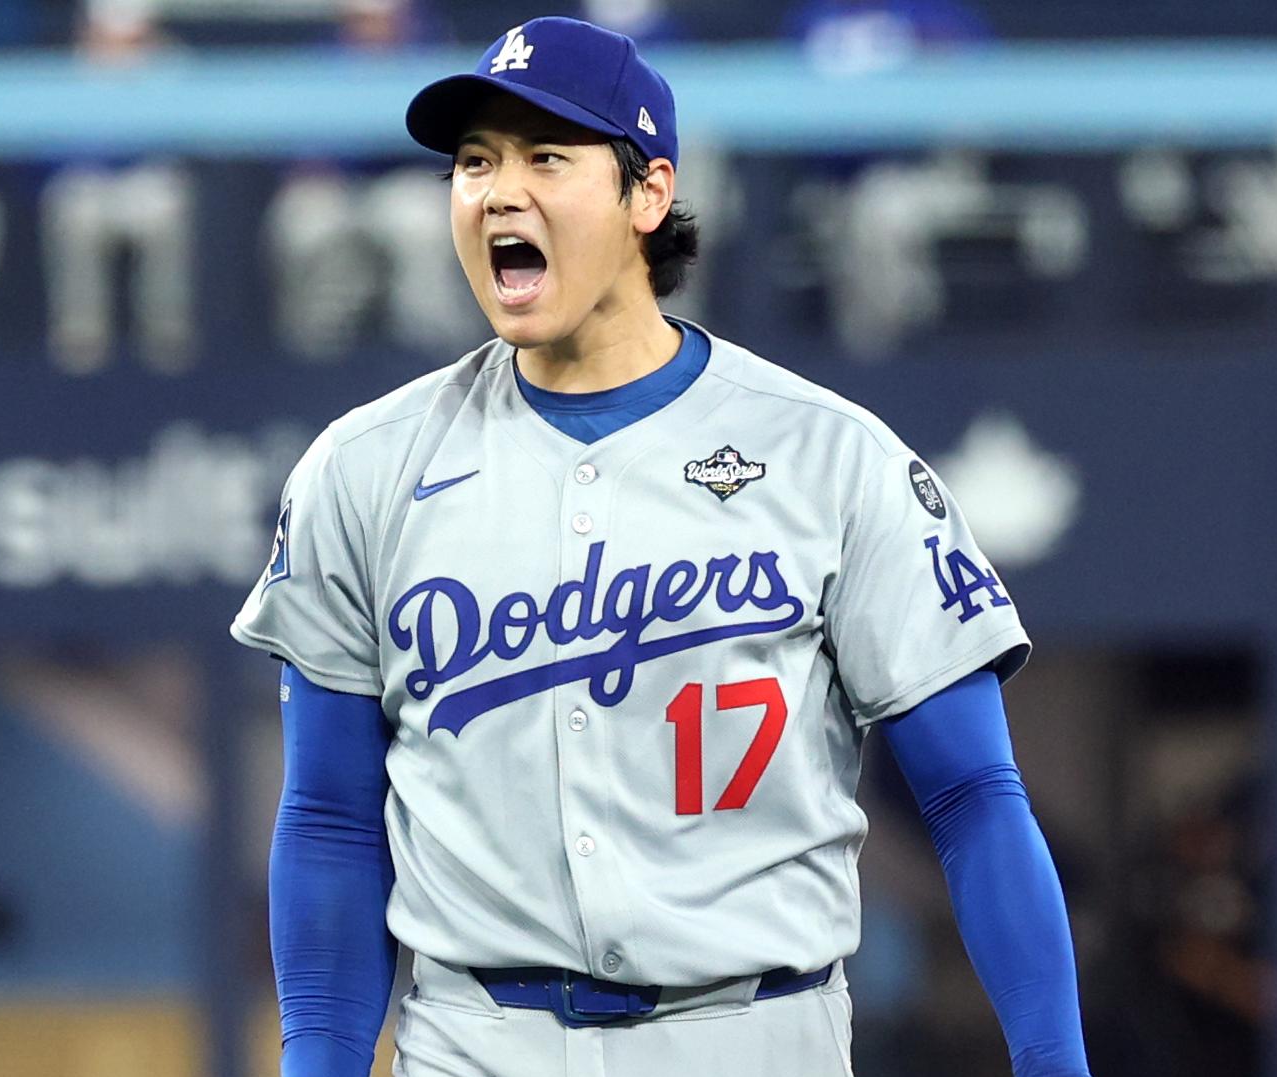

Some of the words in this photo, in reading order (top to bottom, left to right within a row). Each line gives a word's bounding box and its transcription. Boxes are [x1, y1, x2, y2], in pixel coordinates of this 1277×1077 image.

[490, 26, 534, 74] LA
[686, 461, 730, 483] World
[724, 462, 764, 484] Series
[923, 535, 1012, 624] LA
[388, 541, 805, 708] Dodgers
[665, 677, 789, 815] 17
